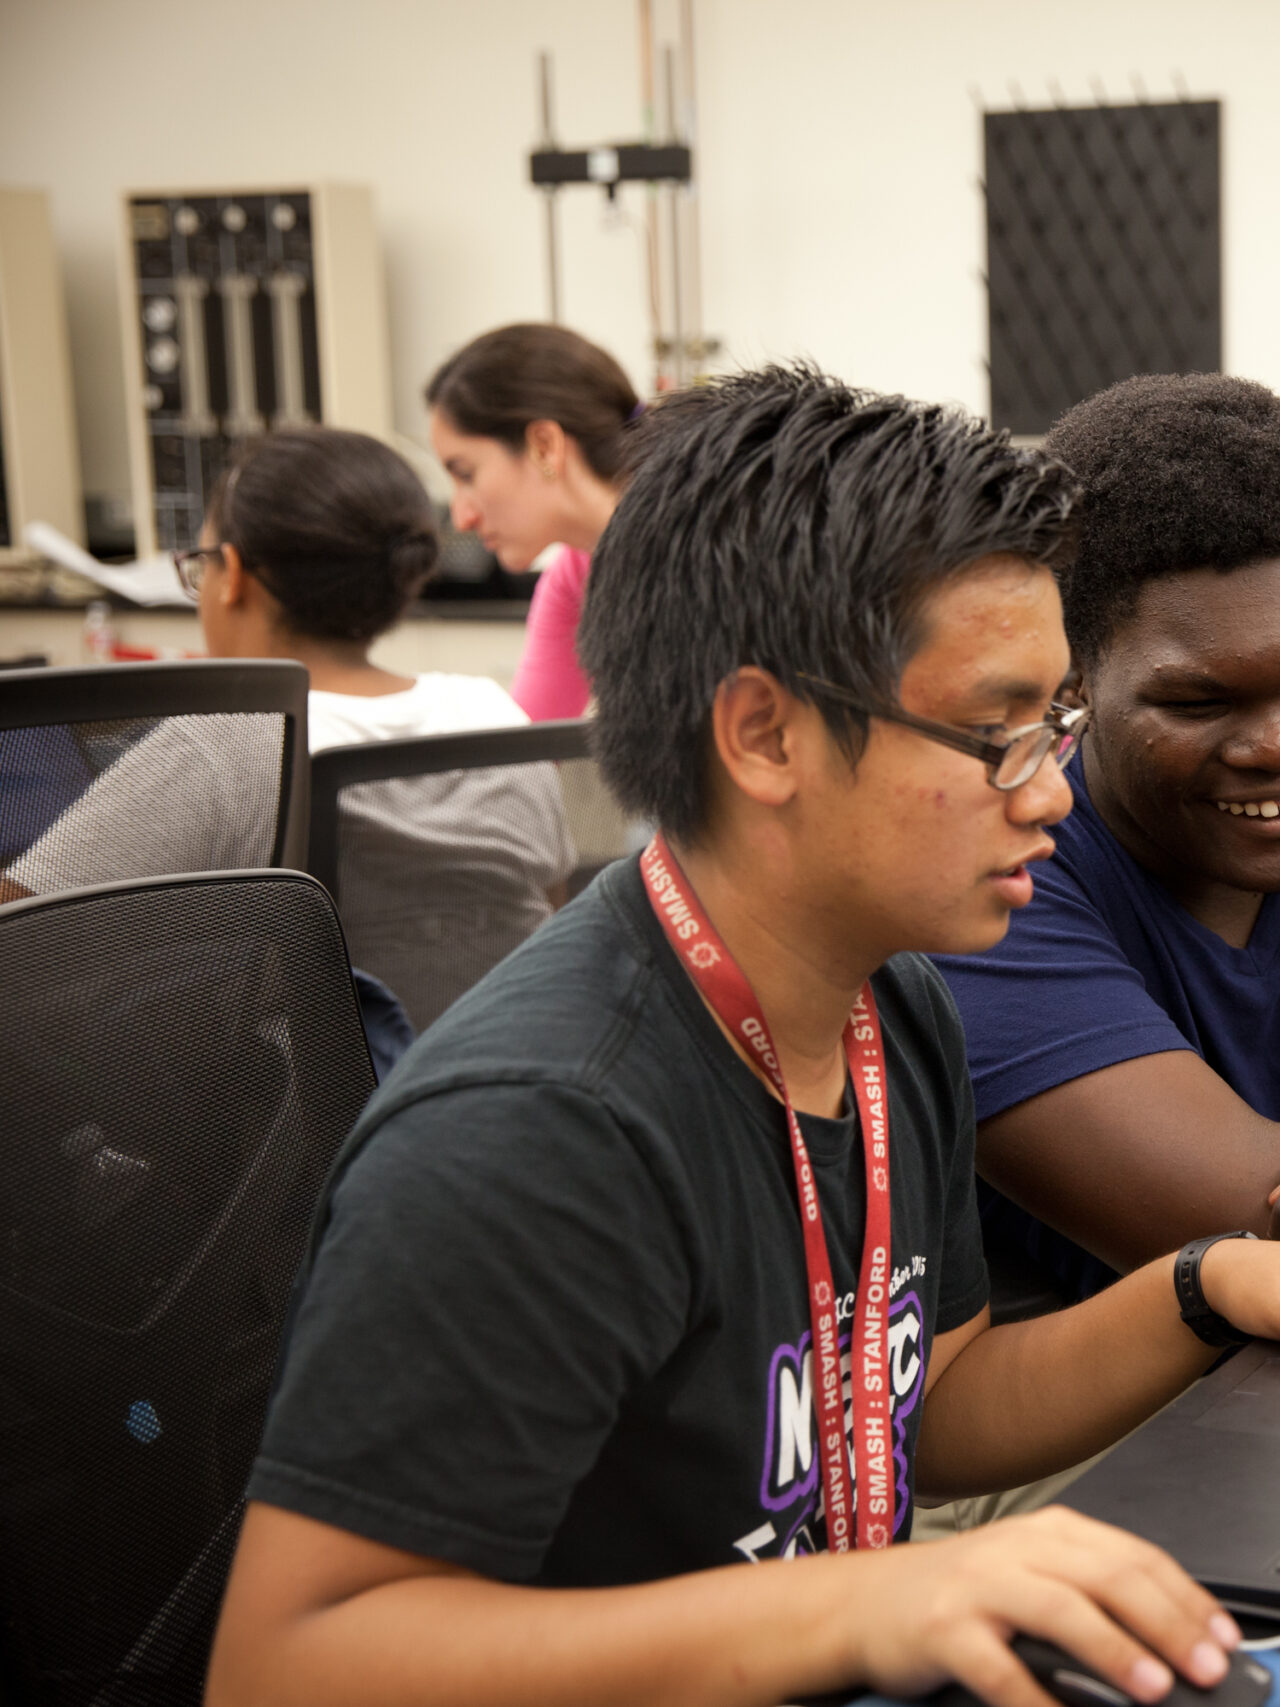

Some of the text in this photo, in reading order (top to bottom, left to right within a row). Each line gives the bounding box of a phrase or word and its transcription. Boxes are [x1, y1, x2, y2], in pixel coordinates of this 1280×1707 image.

[646, 859, 700, 940] SMASH
[862, 1066, 886, 1159] SMASH
[818, 1313, 838, 1411] SMASH
[863, 1246, 887, 1391] STANFORD
[826, 1432, 850, 1555] STANFOR
[865, 1417, 888, 1515] SMASH
